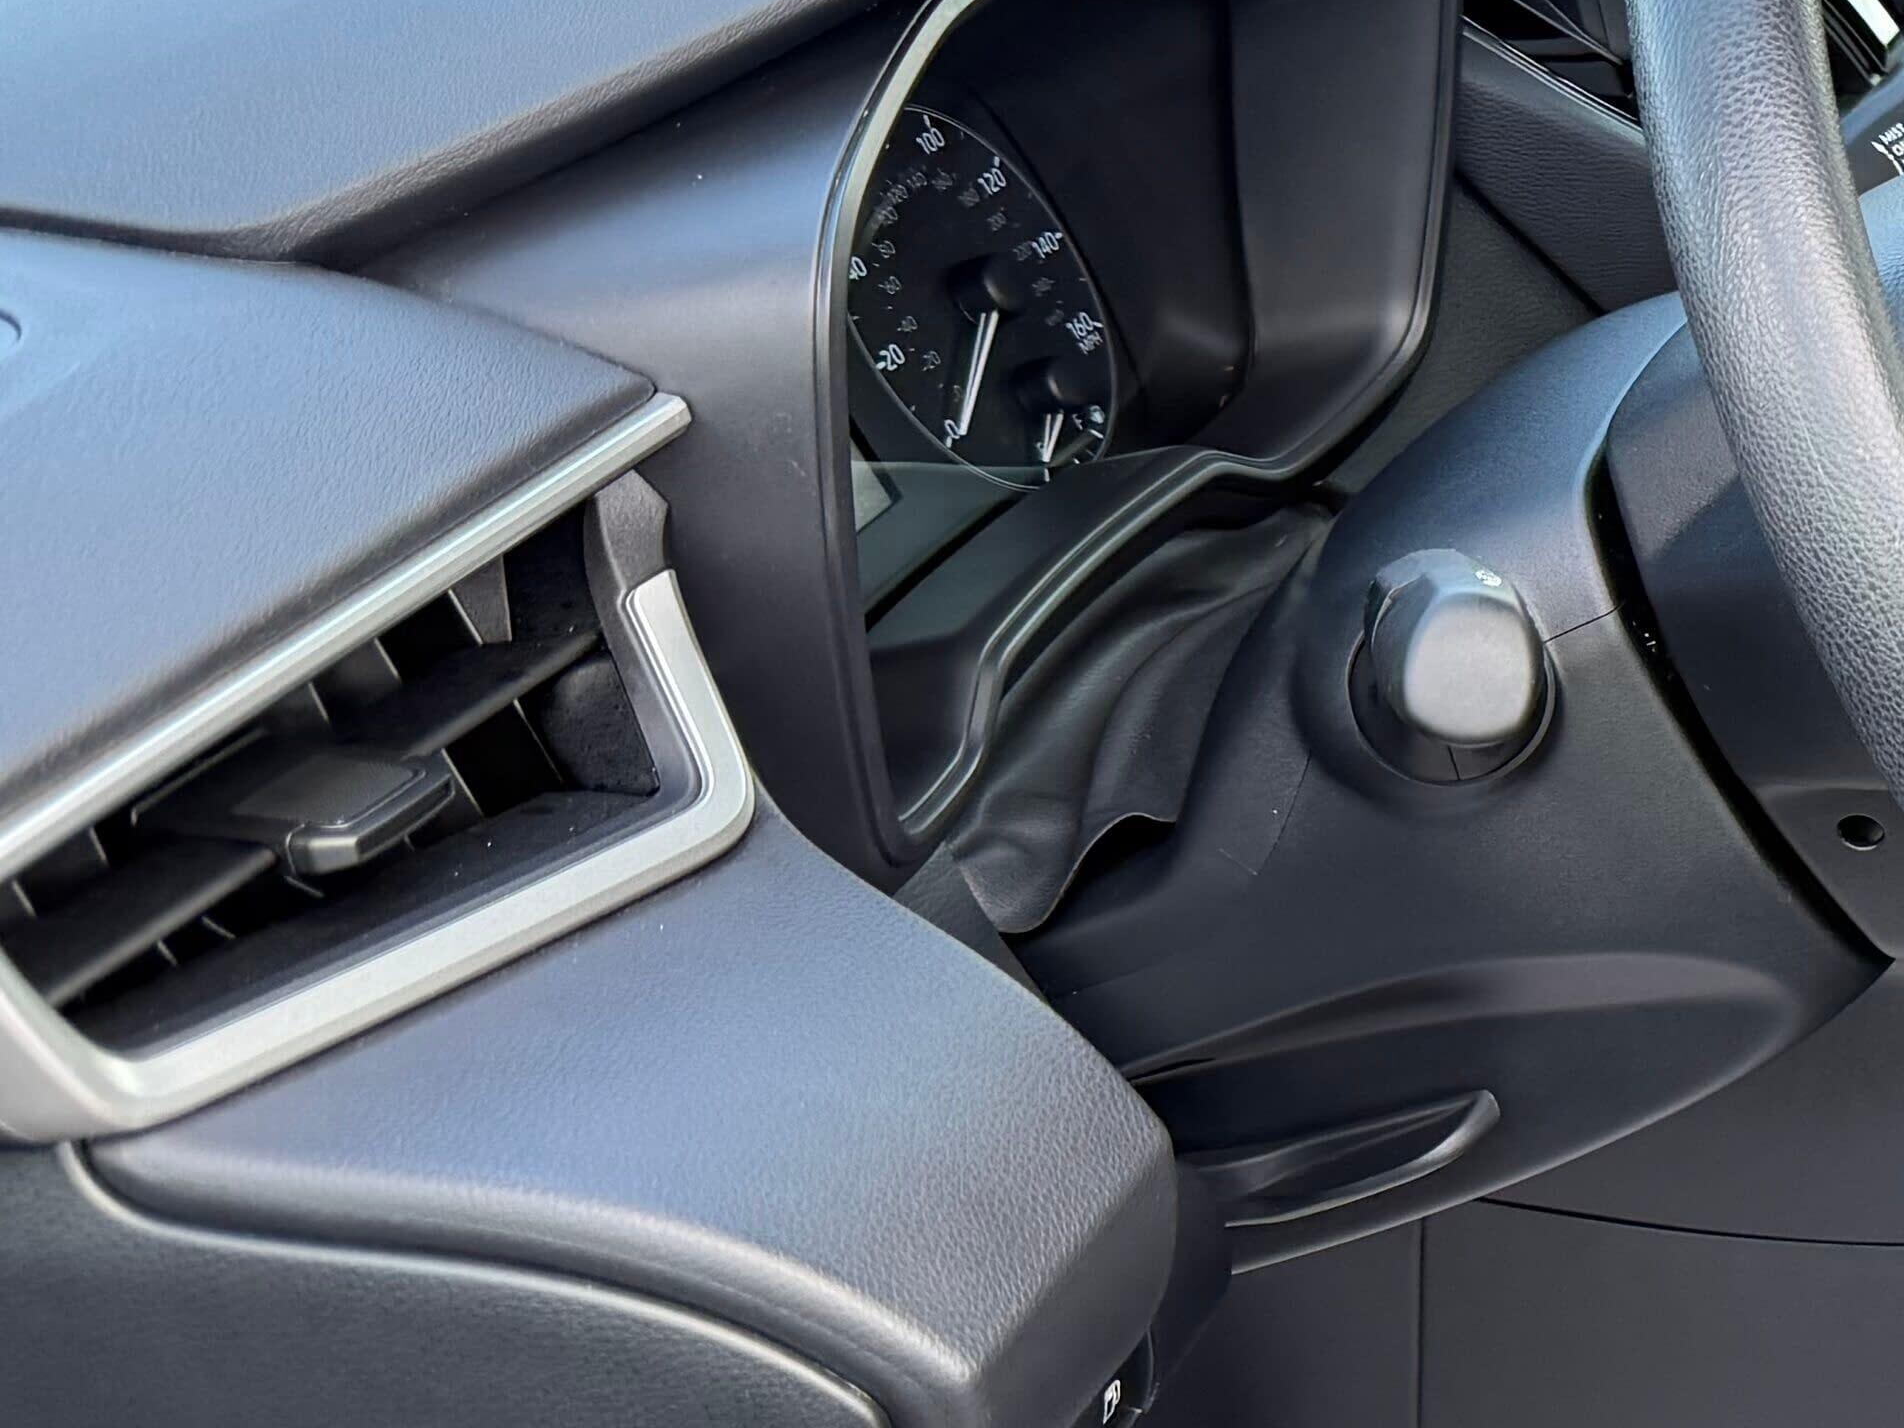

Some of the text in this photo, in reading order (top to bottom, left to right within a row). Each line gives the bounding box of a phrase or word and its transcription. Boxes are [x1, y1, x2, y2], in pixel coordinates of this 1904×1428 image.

[916, 128, 945, 155] 100
[978, 168, 1007, 196] 120
[1032, 232, 1059, 259] 140
[1066, 312, 1094, 339] 160
[1078, 332, 1103, 355] MPH
[880, 344, 905, 371] 20
